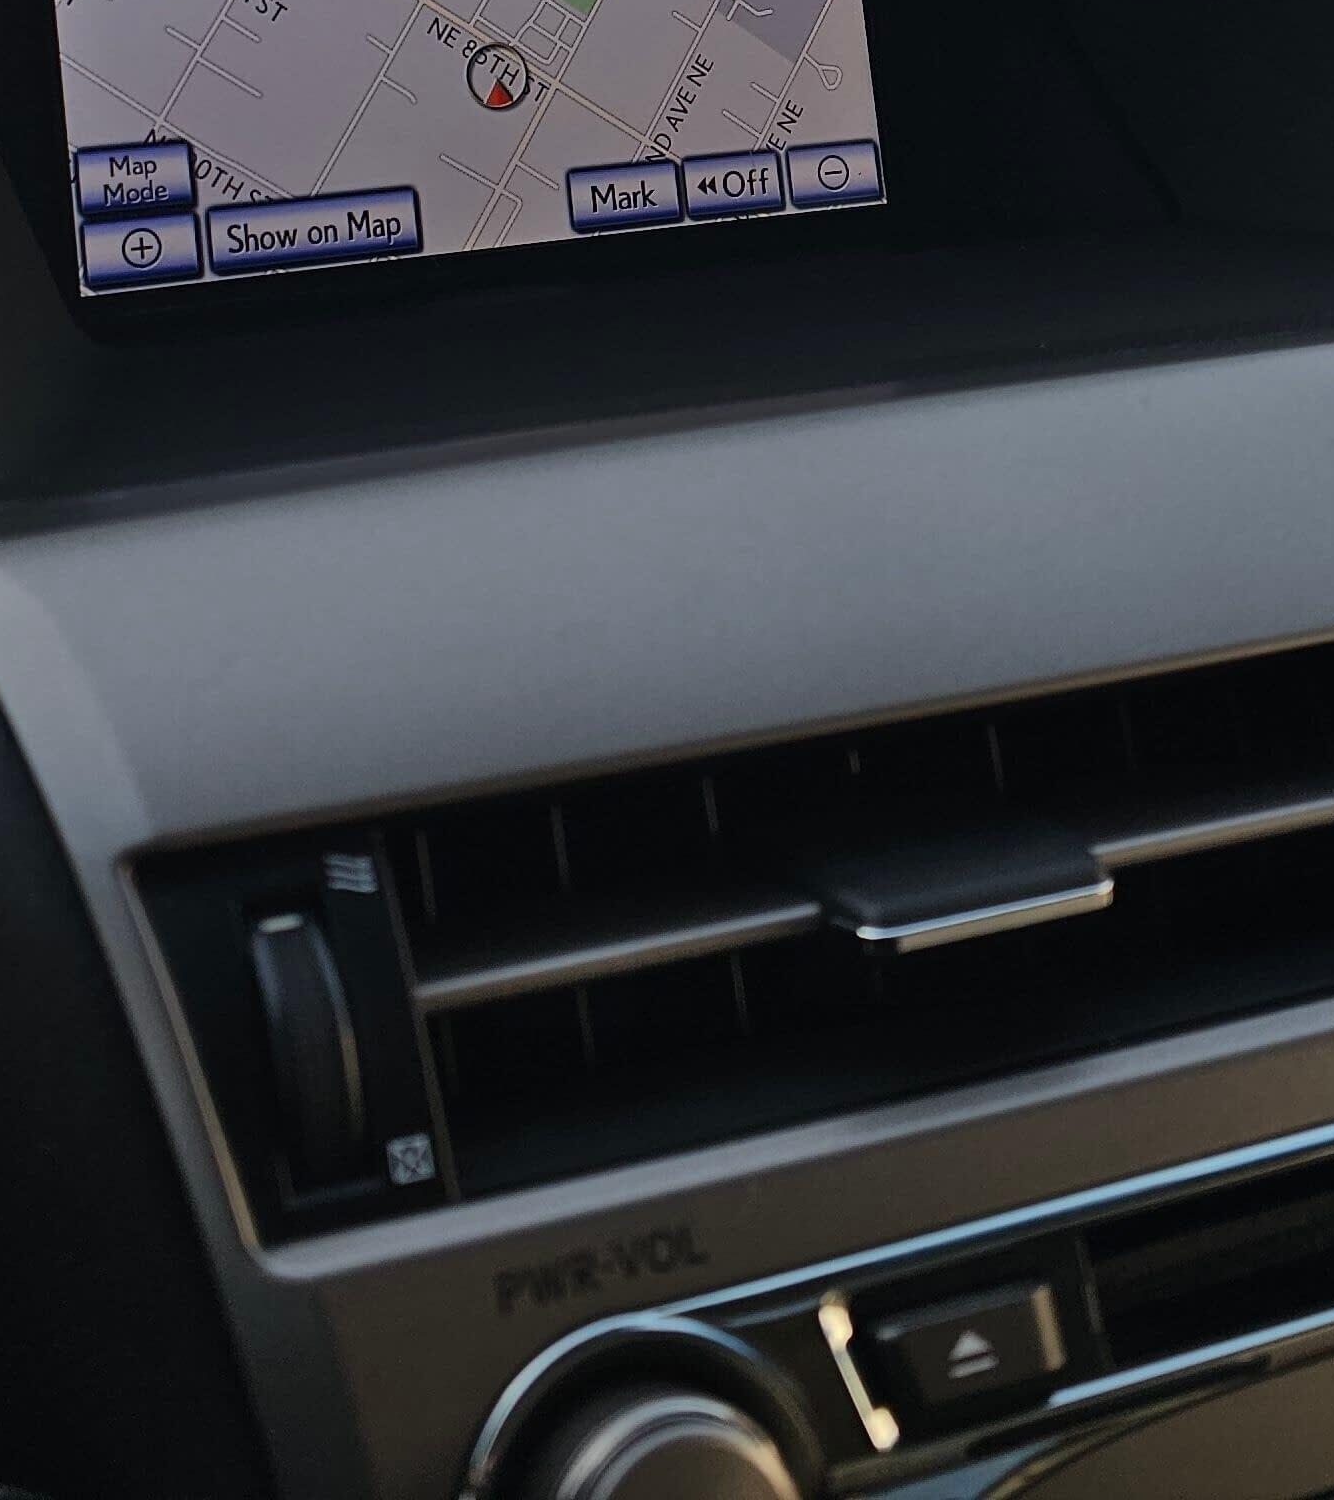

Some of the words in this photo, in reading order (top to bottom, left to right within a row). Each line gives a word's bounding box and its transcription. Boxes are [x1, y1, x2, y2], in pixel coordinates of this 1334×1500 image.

[427, 17, 461, 48] NE
[666, 86, 697, 132] AVE
[686, 54, 714, 87] NE
[777, 100, 804, 134] NE
[109, 155, 157, 179] Map
[722, 167, 769, 198] Off
[103, 181, 169, 206] Mode
[590, 181, 658, 213] Mark
[227, 225, 298, 254] Show
[308, 222, 338, 245] on
[347, 211, 401, 244] Map
